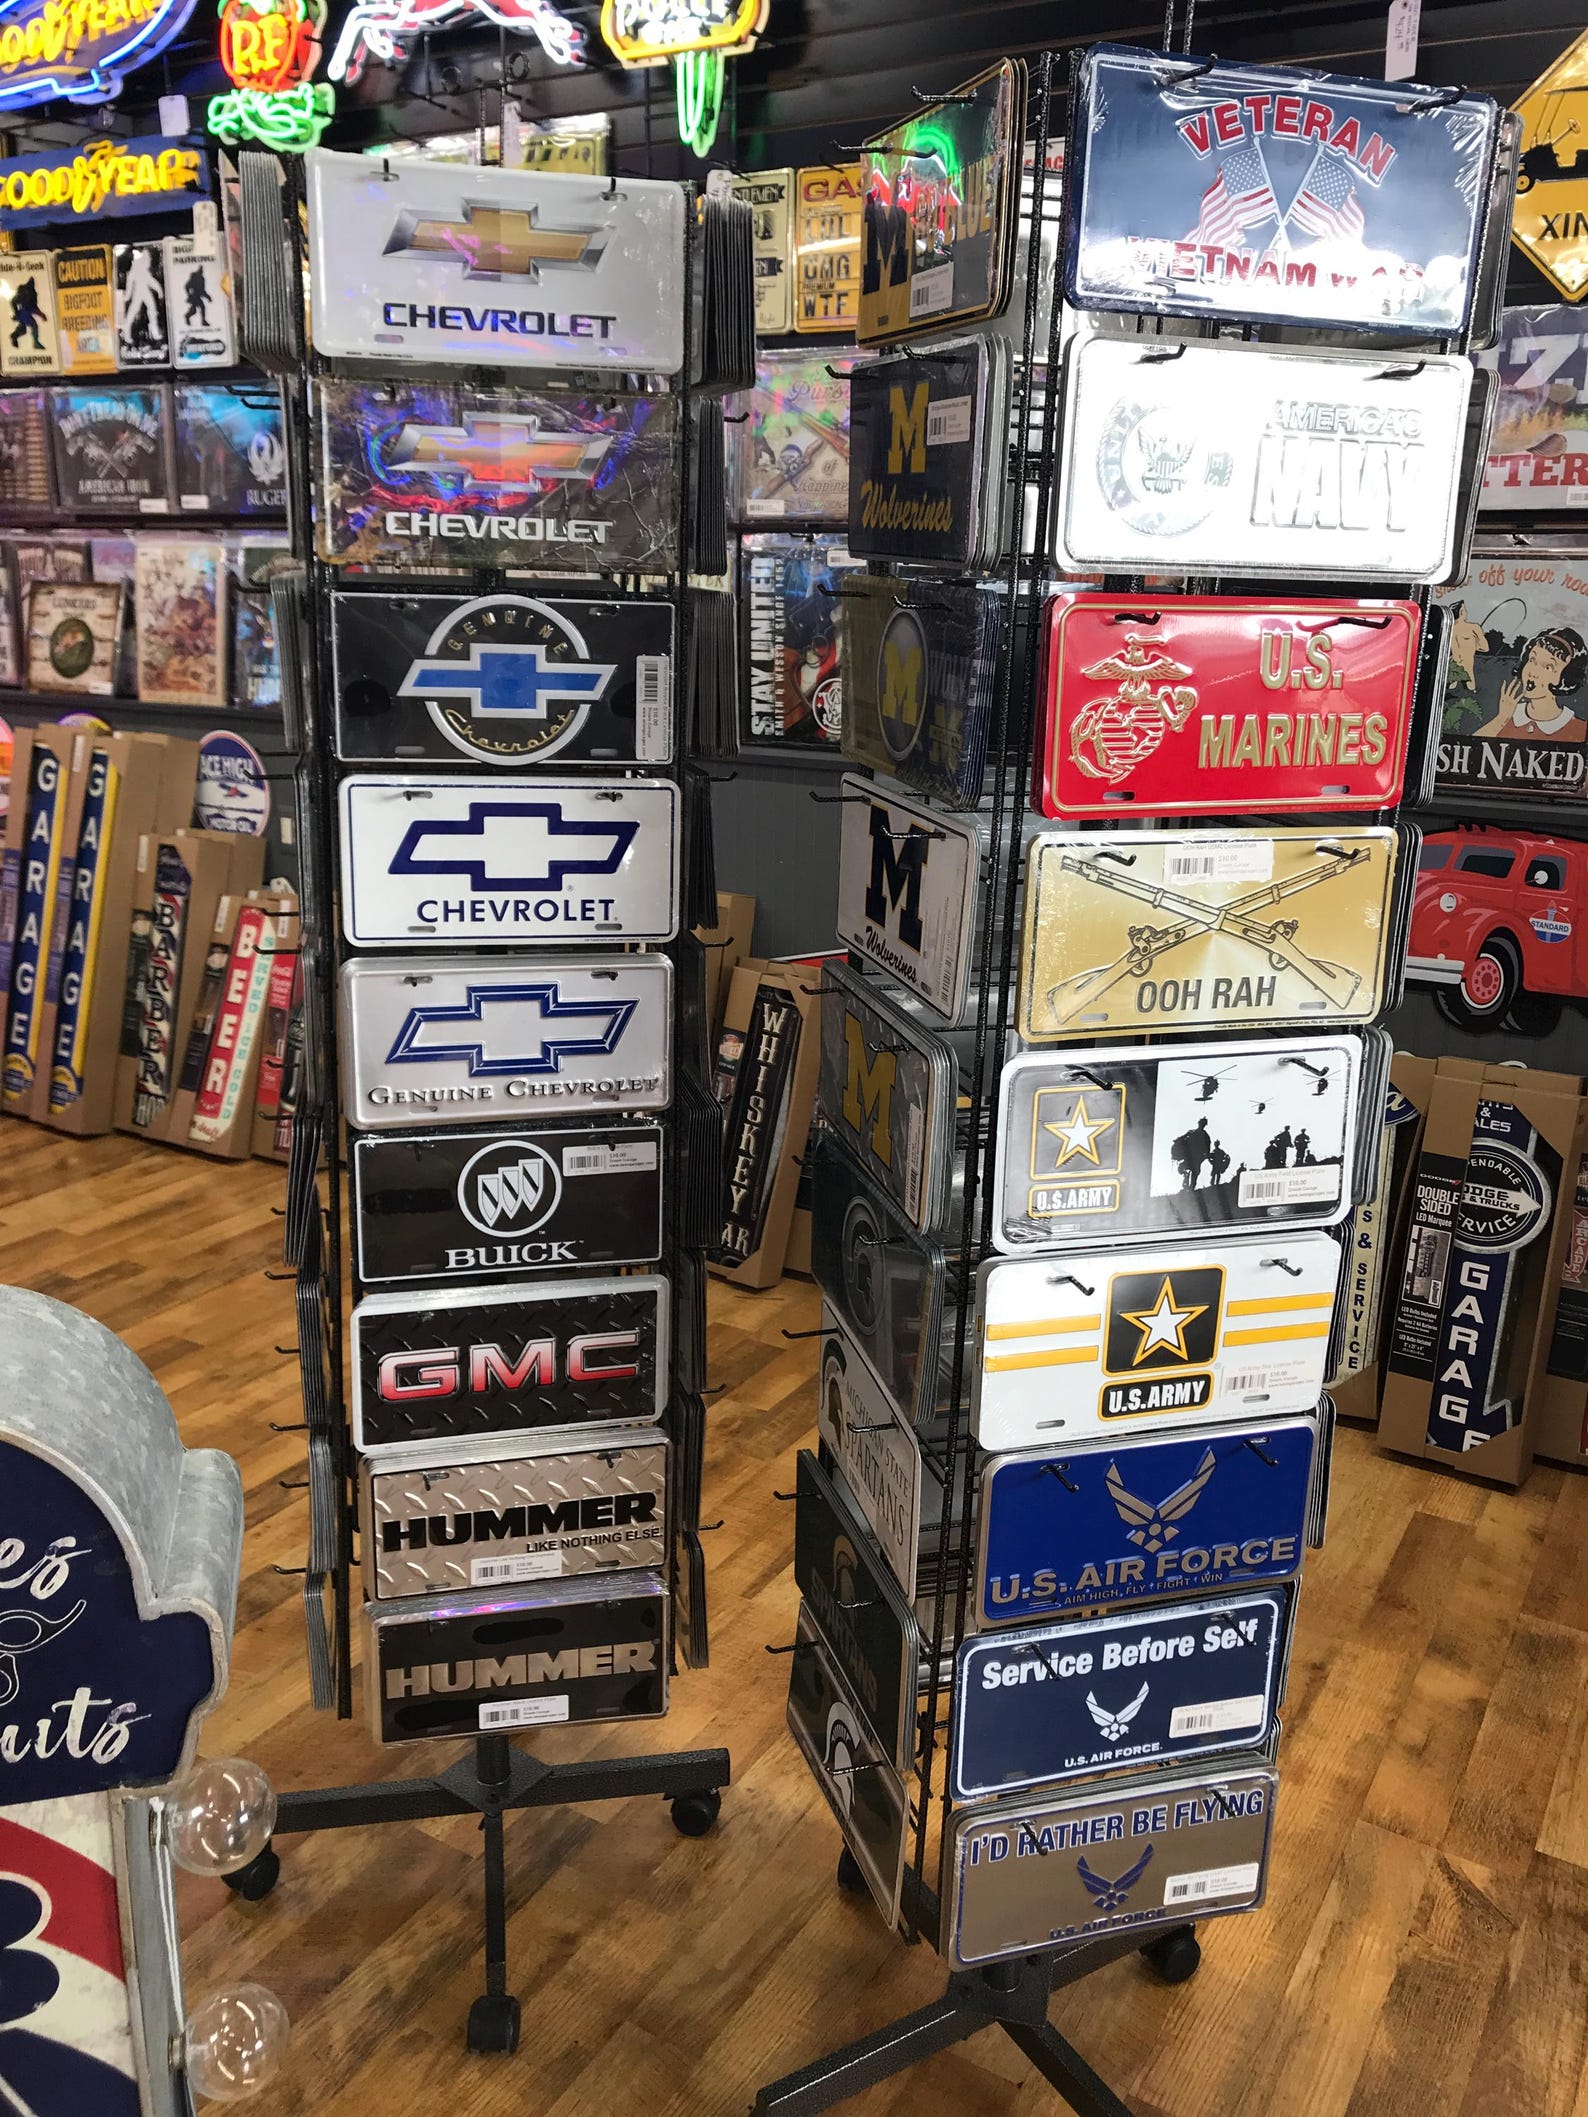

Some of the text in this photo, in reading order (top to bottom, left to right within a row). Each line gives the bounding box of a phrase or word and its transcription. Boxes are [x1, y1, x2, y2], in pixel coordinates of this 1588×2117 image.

[1177, 94, 1396, 188] VETERAN
[863, 190, 909, 295] M
[1538, 212, 1588, 242] XIN
[58, 258, 107, 283] CAUTION
[803, 281, 836, 291] PREMIUM
[63, 291, 103, 311] BIGFOOT
[383, 303, 617, 339] CHEVROLET
[804, 291, 849, 318] WTF
[8, 356, 53, 367] CHAMPION
[888, 381, 929, 475] M
[792, 477, 849, 497] Happine
[860, 480, 954, 532] Wolverines
[385, 511, 615, 544] CHEVROLET
[1479, 563, 1507, 587] off
[1512, 566, 1555, 587] your
[447, 609, 569, 655] GENUINE
[750, 557, 776, 737] STAY UNITED
[775, 635, 785, 683] WESSON
[1260, 629, 1345, 692] U.S.
[882, 641, 923, 726] M
[445, 708, 575, 753] Chevrolet
[775, 696, 785, 737] SMITH
[1198, 712, 1388, 769] MARINES
[1436, 741, 1585, 782] SH NAKED
[866, 801, 931, 957] M
[11, 757, 57, 1048] GARAGE
[56, 762, 106, 1059] GARAGE
[416, 899, 616, 923] CHEVROLET
[1531, 917, 1570, 933] STANDARD
[865, 925, 918, 984] Wolverines
[139, 902, 177, 1086] BARBER
[204, 923, 257, 1095] BEER
[1136, 975, 1278, 1014] OOH RAH
[367, 1077, 660, 1105] GENUINE CHEVROLET
[730, 1002, 789, 1217] WHISKEY
[842, 1008, 898, 1174] M
[1479, 1106, 1492, 1119] &
[1417, 1184, 1461, 1206] DOUBLE
[1419, 1198, 1452, 1217] SIDED
[1479, 1197, 1521, 1212] TRUCKS
[720, 1222, 750, 1257] AR
[1415, 1211, 1453, 1228] LED Marquee
[444, 1241, 579, 1270] BUICK
[1347, 1232, 1373, 1371] & SERVICE
[377, 1328, 640, 1402] GMC
[844, 1411, 905, 1547] SPARTANS
[885, 1446, 910, 1499] STATE
[381, 1491, 658, 1553] HUMMER
[526, 1539, 558, 1554] LIKE
[560, 1531, 623, 1551] NOTHING
[989, 1535, 1296, 1605] U.S. AIR FORCE
[1063, 1593, 1087, 1606] AIM
[1125, 1583, 1147, 1596] FLY
[1156, 1576, 1192, 1591] FIGHT
[1201, 1571, 1224, 1584] WIN
[386, 1642, 657, 1700] HUMMER
[981, 1617, 1258, 1690] Service Before Self
[1064, 1755, 1086, 1768] U.S.
[1088, 1750, 1110, 1764] AIR
[970, 1789, 1265, 1866] I'D RATHER BE FLYING
[1081, 1917, 1109, 1933] AIR
[1110, 1905, 1168, 1927] FORCE
